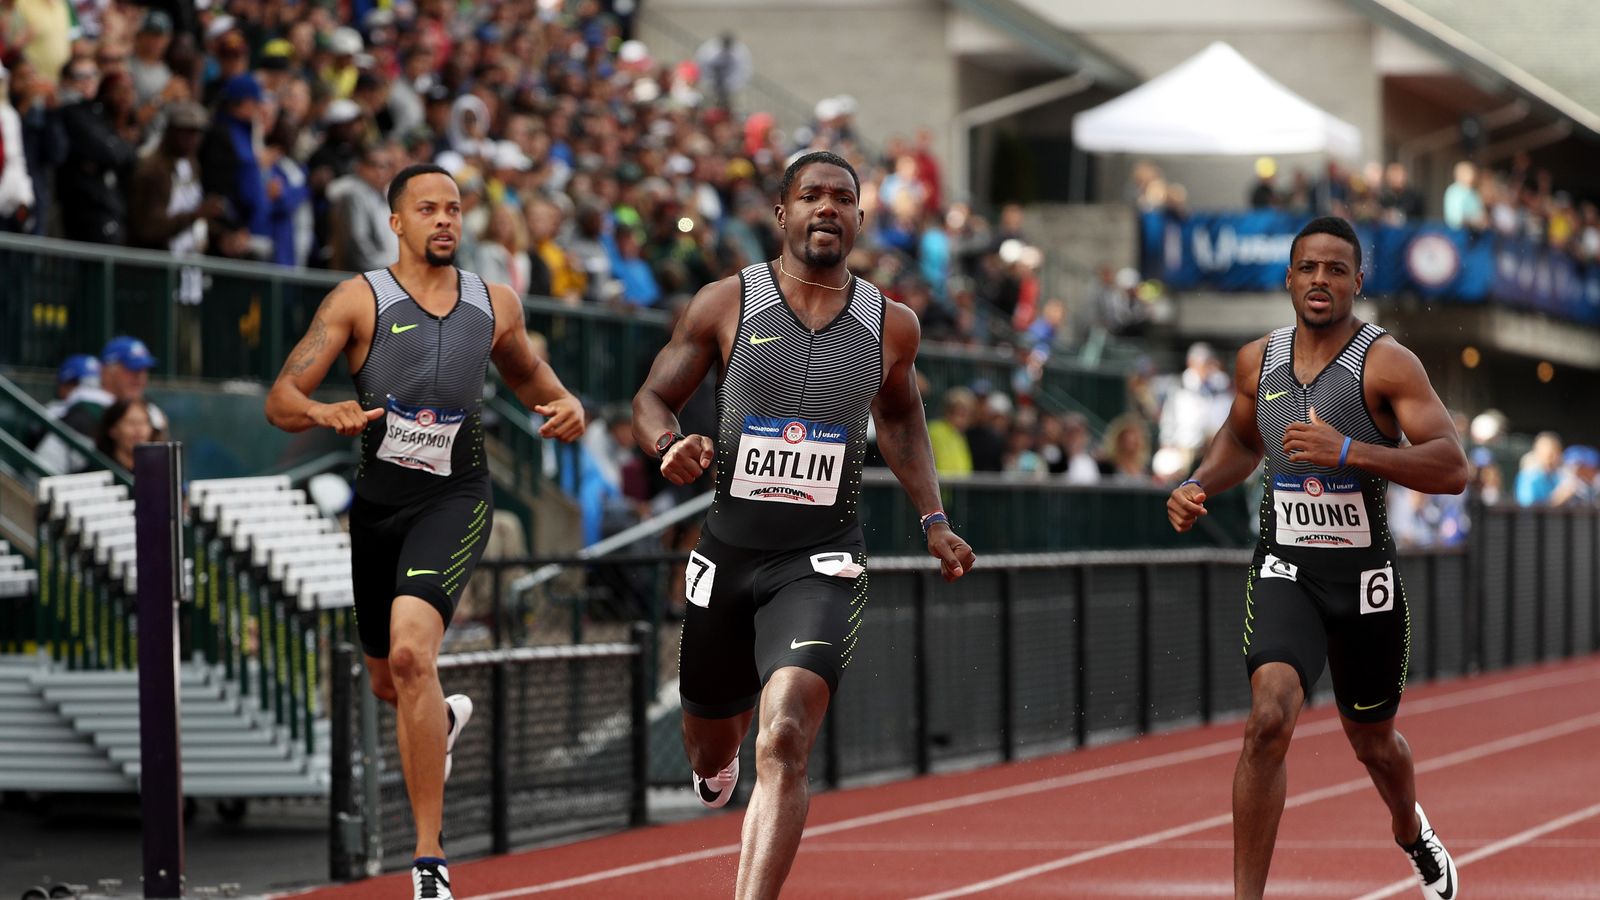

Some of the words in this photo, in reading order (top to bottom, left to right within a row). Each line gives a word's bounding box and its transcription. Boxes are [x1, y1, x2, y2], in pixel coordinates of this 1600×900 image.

[745, 448, 835, 481] GATLIN
[1281, 502, 1360, 526] YOUNG
[691, 556, 710, 598] 7
[1367, 572, 1389, 608] 6
